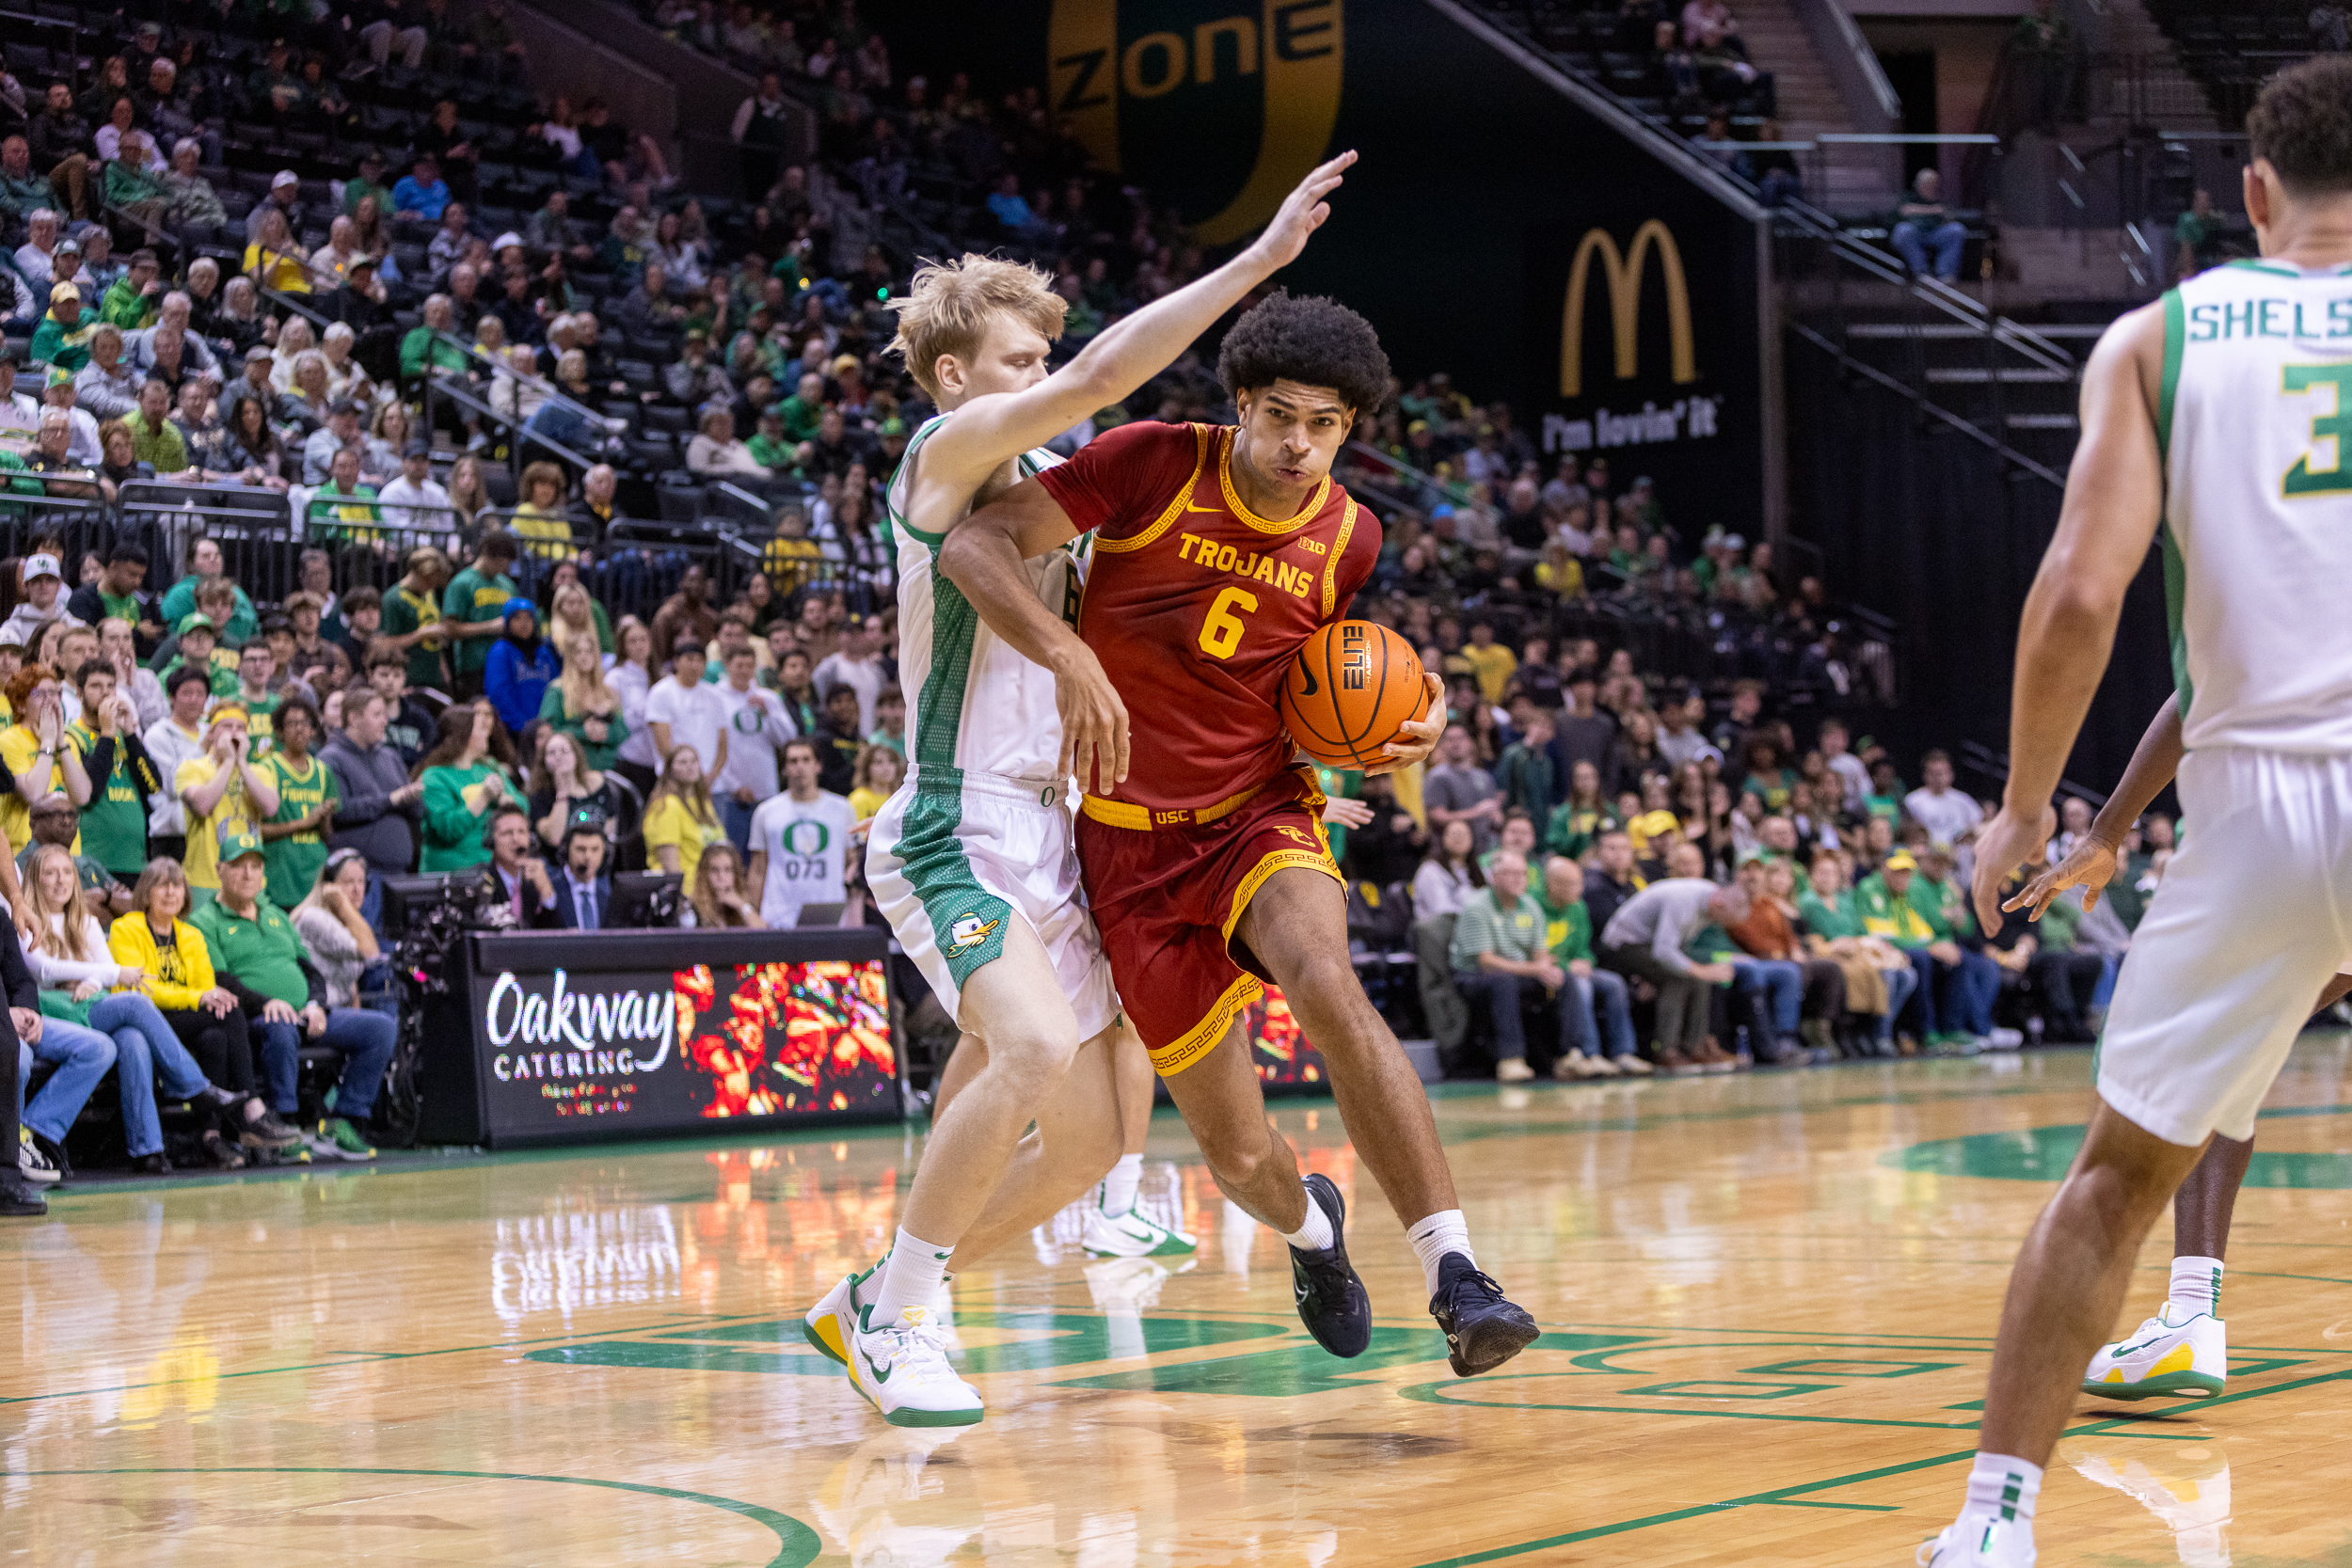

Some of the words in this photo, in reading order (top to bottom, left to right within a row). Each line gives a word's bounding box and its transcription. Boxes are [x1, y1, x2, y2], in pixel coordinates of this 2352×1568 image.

[1179, 532, 1315, 599] TROJANS
[1198, 585, 1260, 660] 6
[1342, 625, 1365, 690] ELITE
[1155, 809, 1190, 826] USC
[485, 968, 675, 1072] Oakway
[493, 1047, 635, 1082] CATERING
